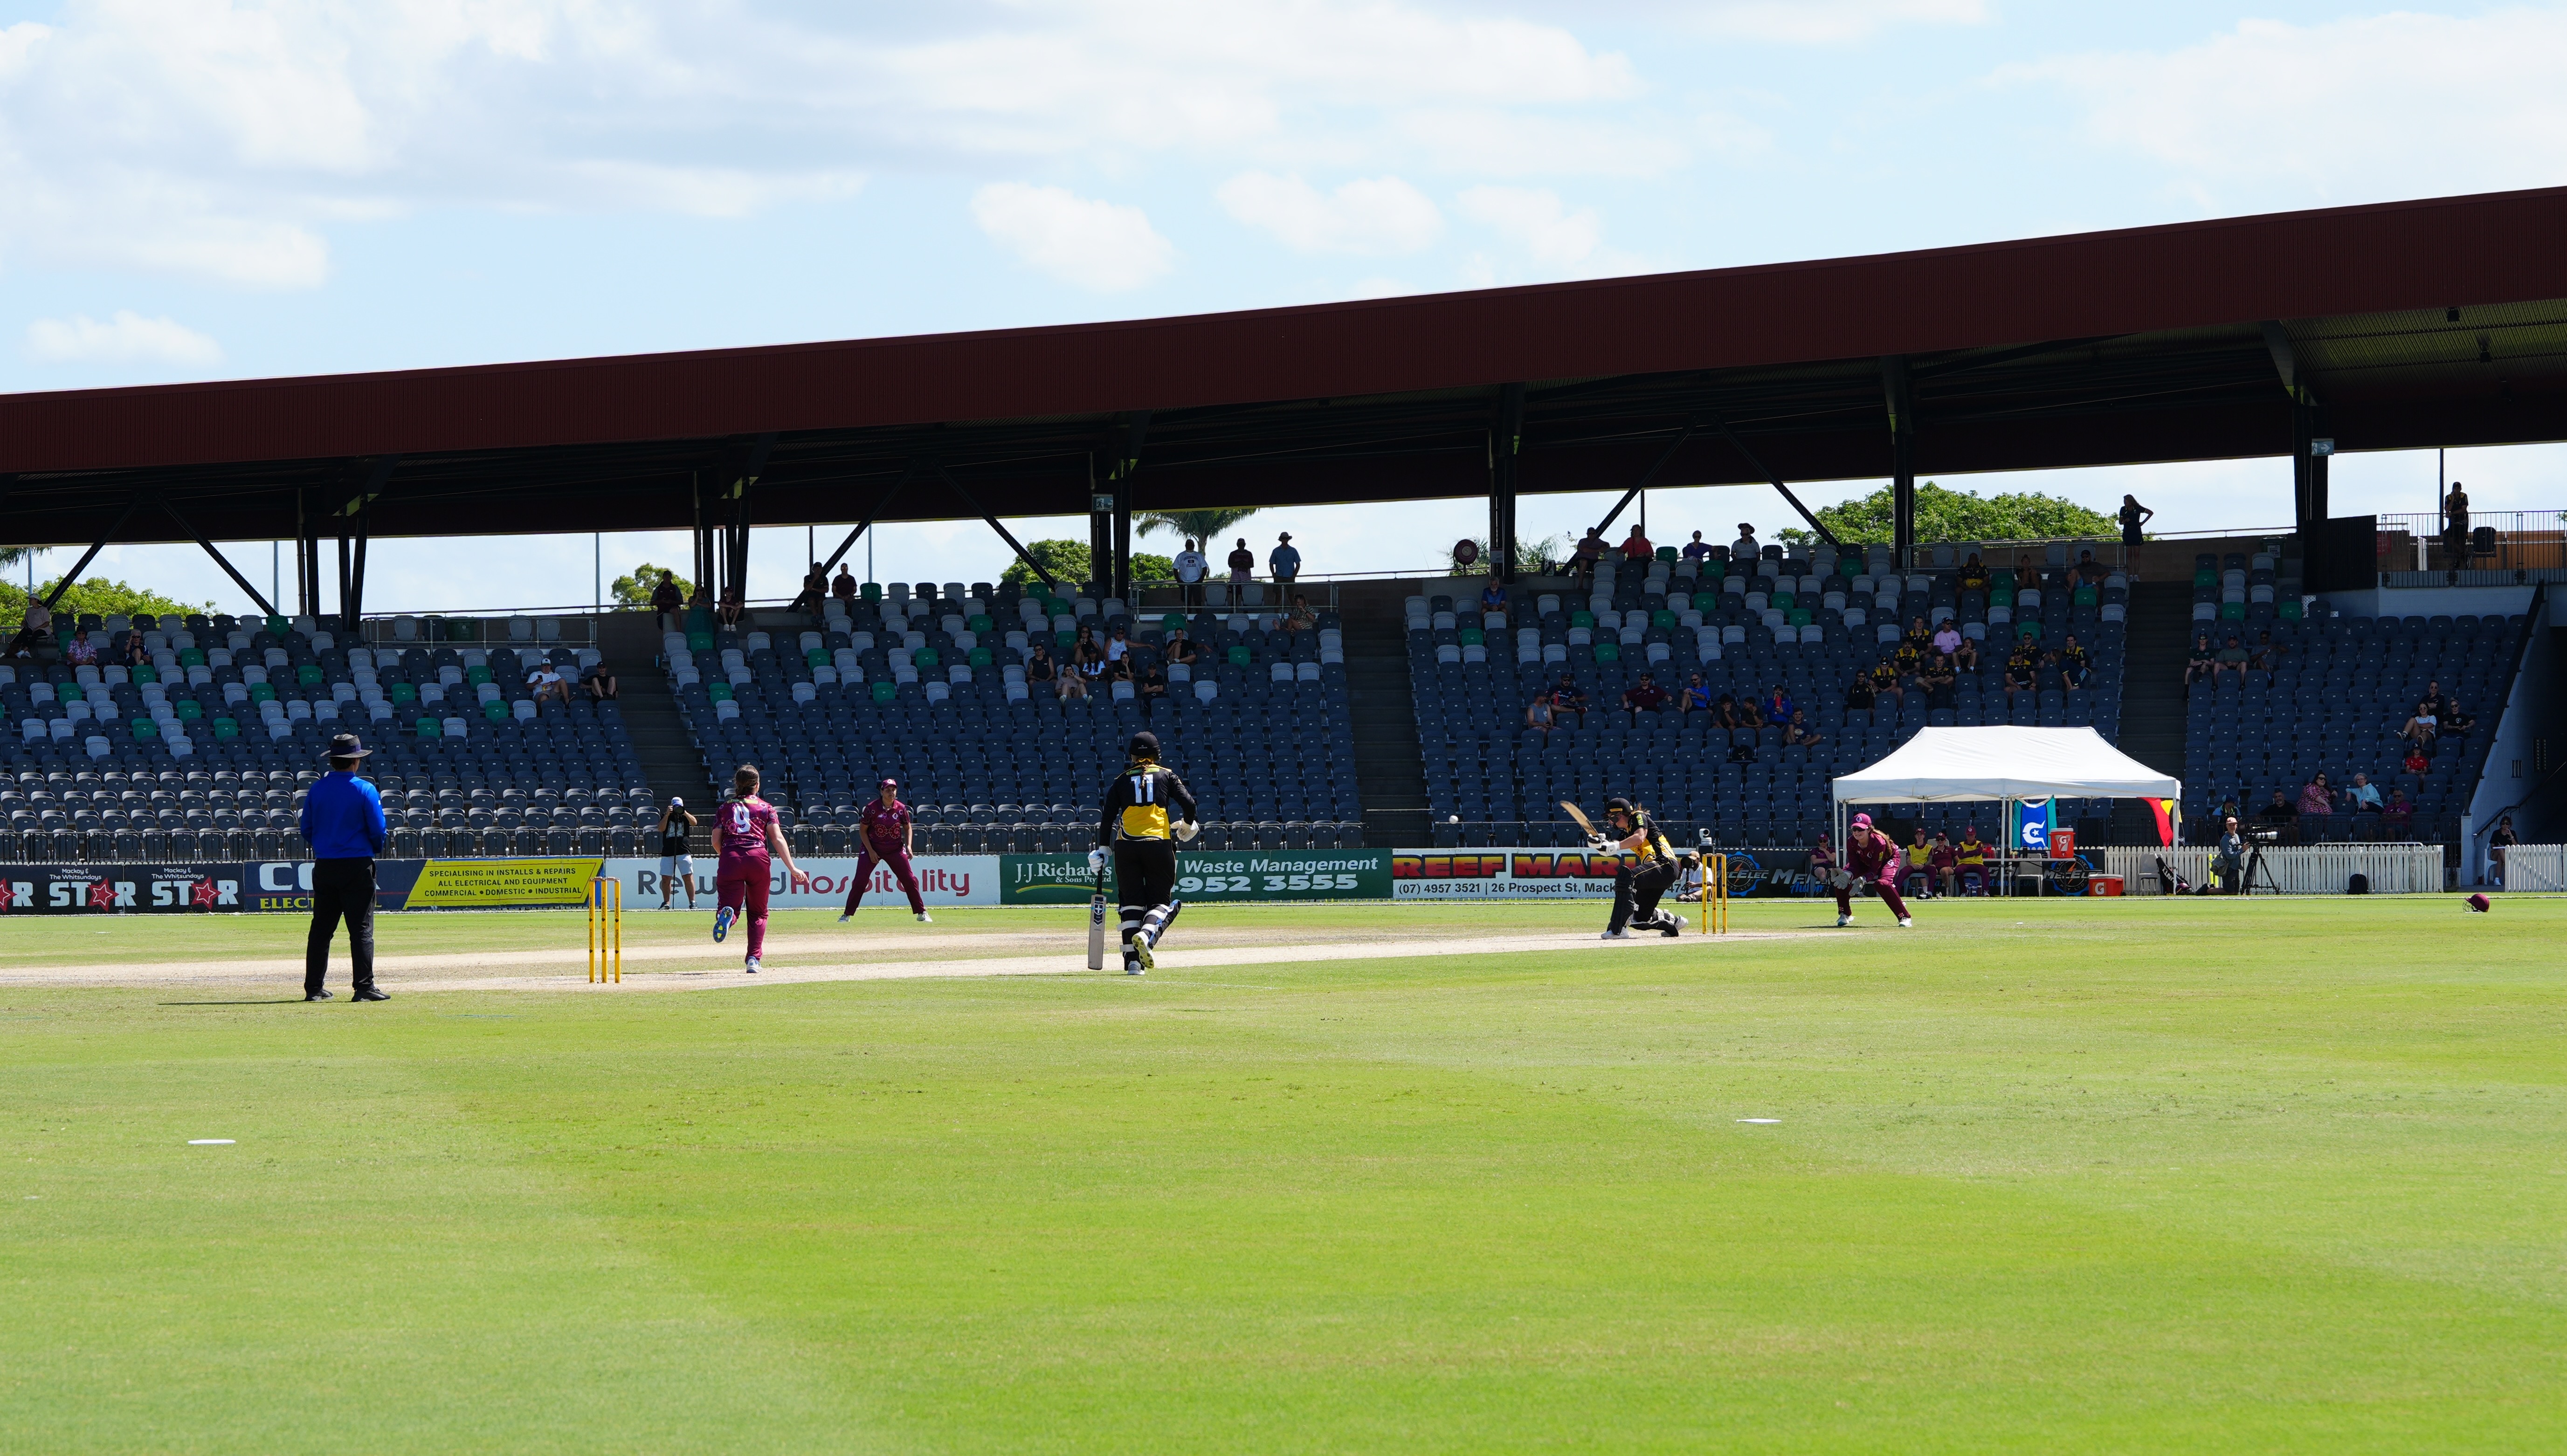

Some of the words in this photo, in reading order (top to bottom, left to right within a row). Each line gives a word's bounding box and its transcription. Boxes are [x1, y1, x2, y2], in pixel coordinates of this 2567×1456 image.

[1131, 774, 1153, 803] 11
[734, 805, 751, 833] 9
[1184, 860, 1244, 873] Waste
[1250, 858, 1378, 874] Management
[1393, 854, 1505, 878] REEF
[1084, 876, 1097, 884] Pty
[1263, 874, 1359, 891] 3555
[1399, 883, 1421, 894] (07)
[1424, 883, 1451, 893] 4957
[1455, 883, 1480, 893] 3521
[1491, 883, 1505, 893] 26
[1509, 882, 1561, 894] Prospect
[1565, 882, 1581, 894] St,
[2095, 882, 2105, 895] G
